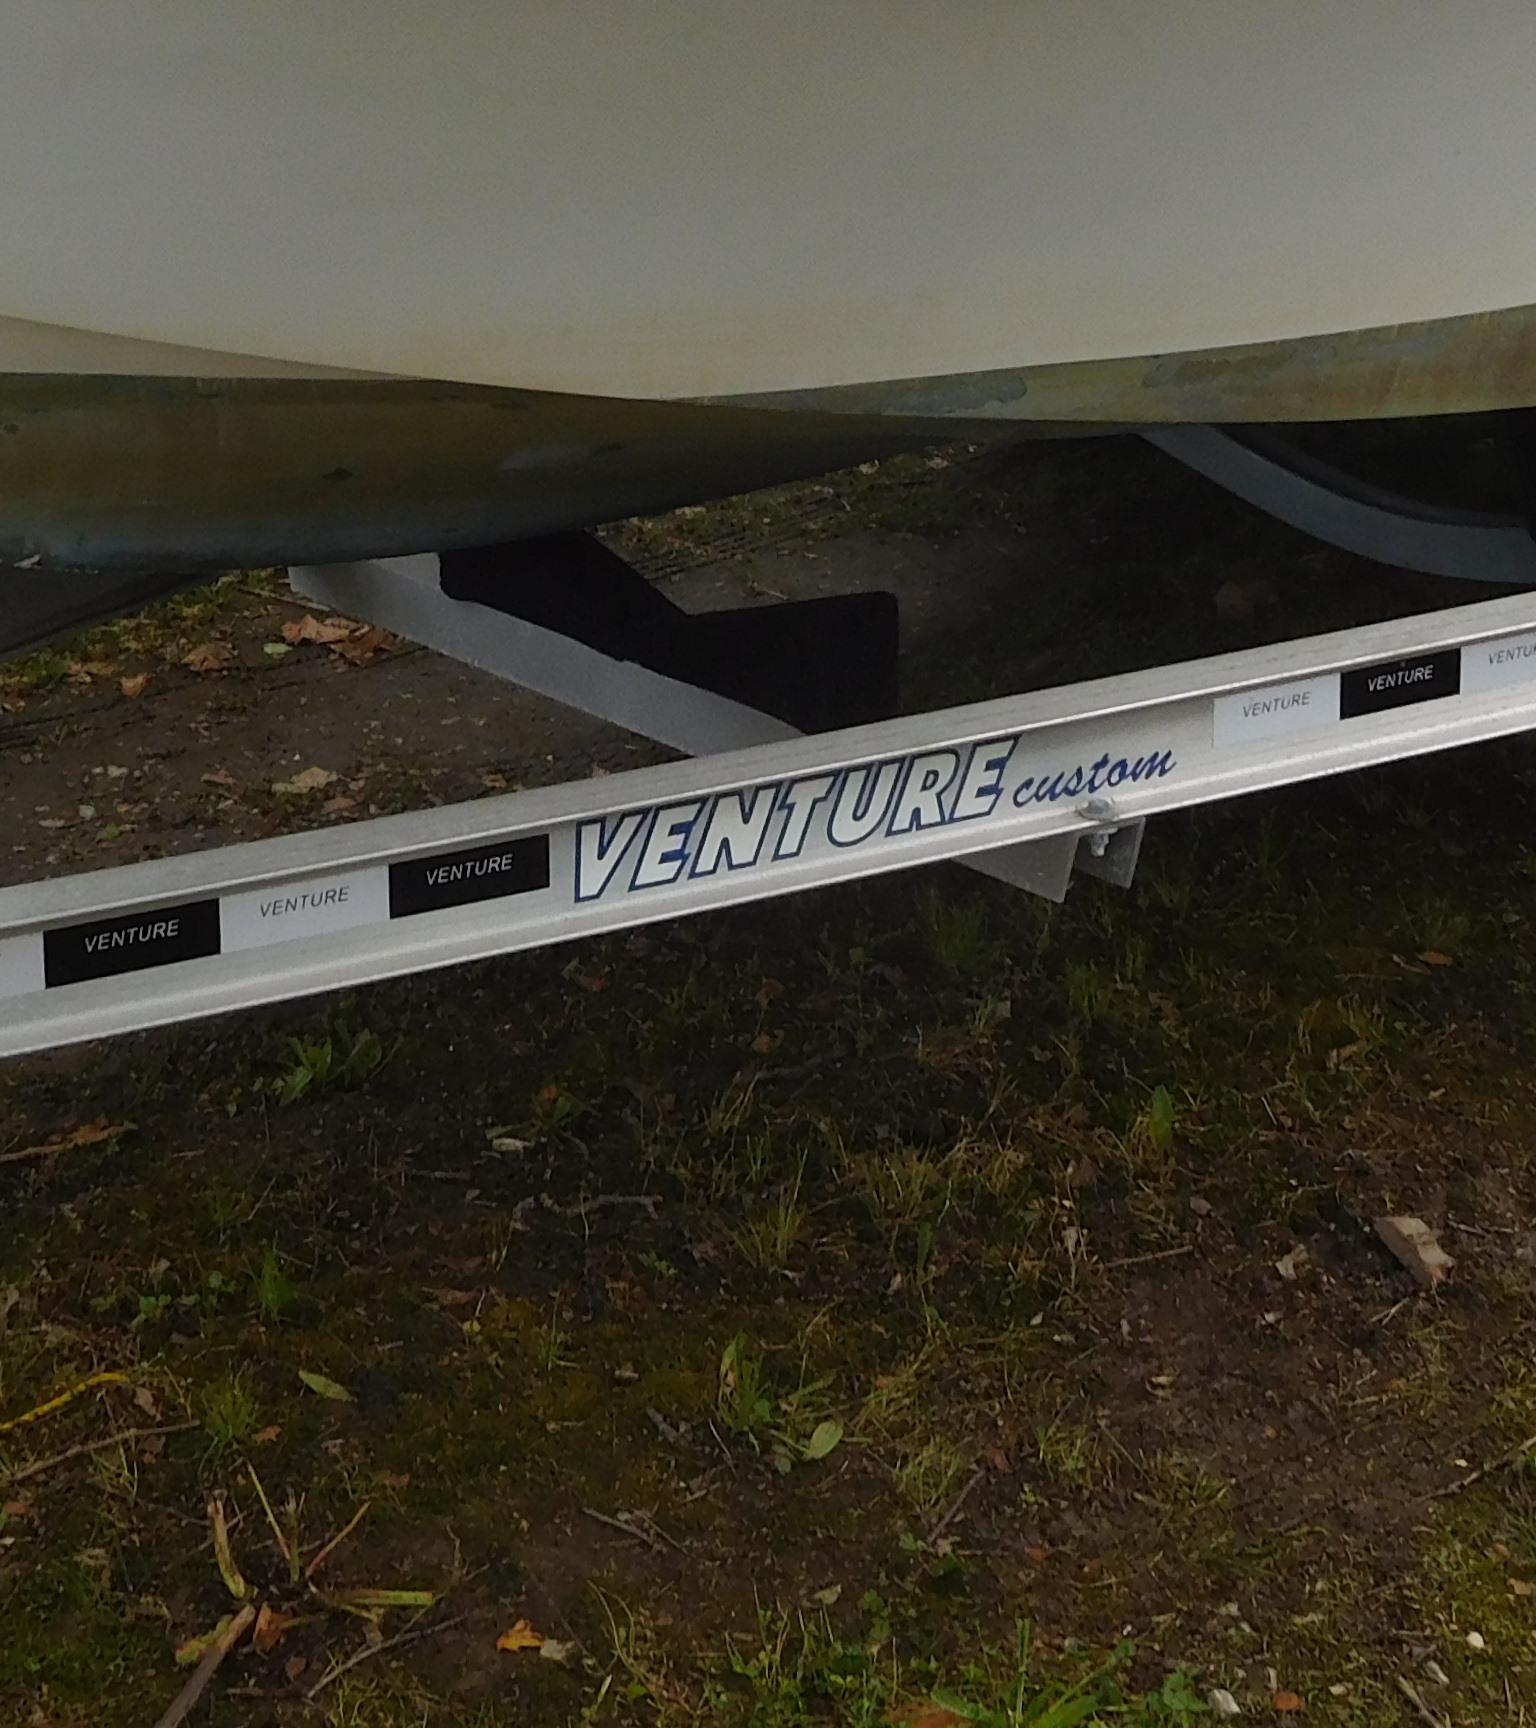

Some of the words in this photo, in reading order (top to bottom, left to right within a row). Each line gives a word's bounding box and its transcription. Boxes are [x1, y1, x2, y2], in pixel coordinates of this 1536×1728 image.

[1367, 666, 1433, 692] VENTURE
[1242, 691, 1311, 717] VENTURE
[575, 735, 1023, 903] VENTURE
[1013, 748, 1177, 809] custom
[426, 854, 513, 886] VENTURE
[260, 886, 350, 917] VENTURE
[84, 919, 180, 953] VENTURE
